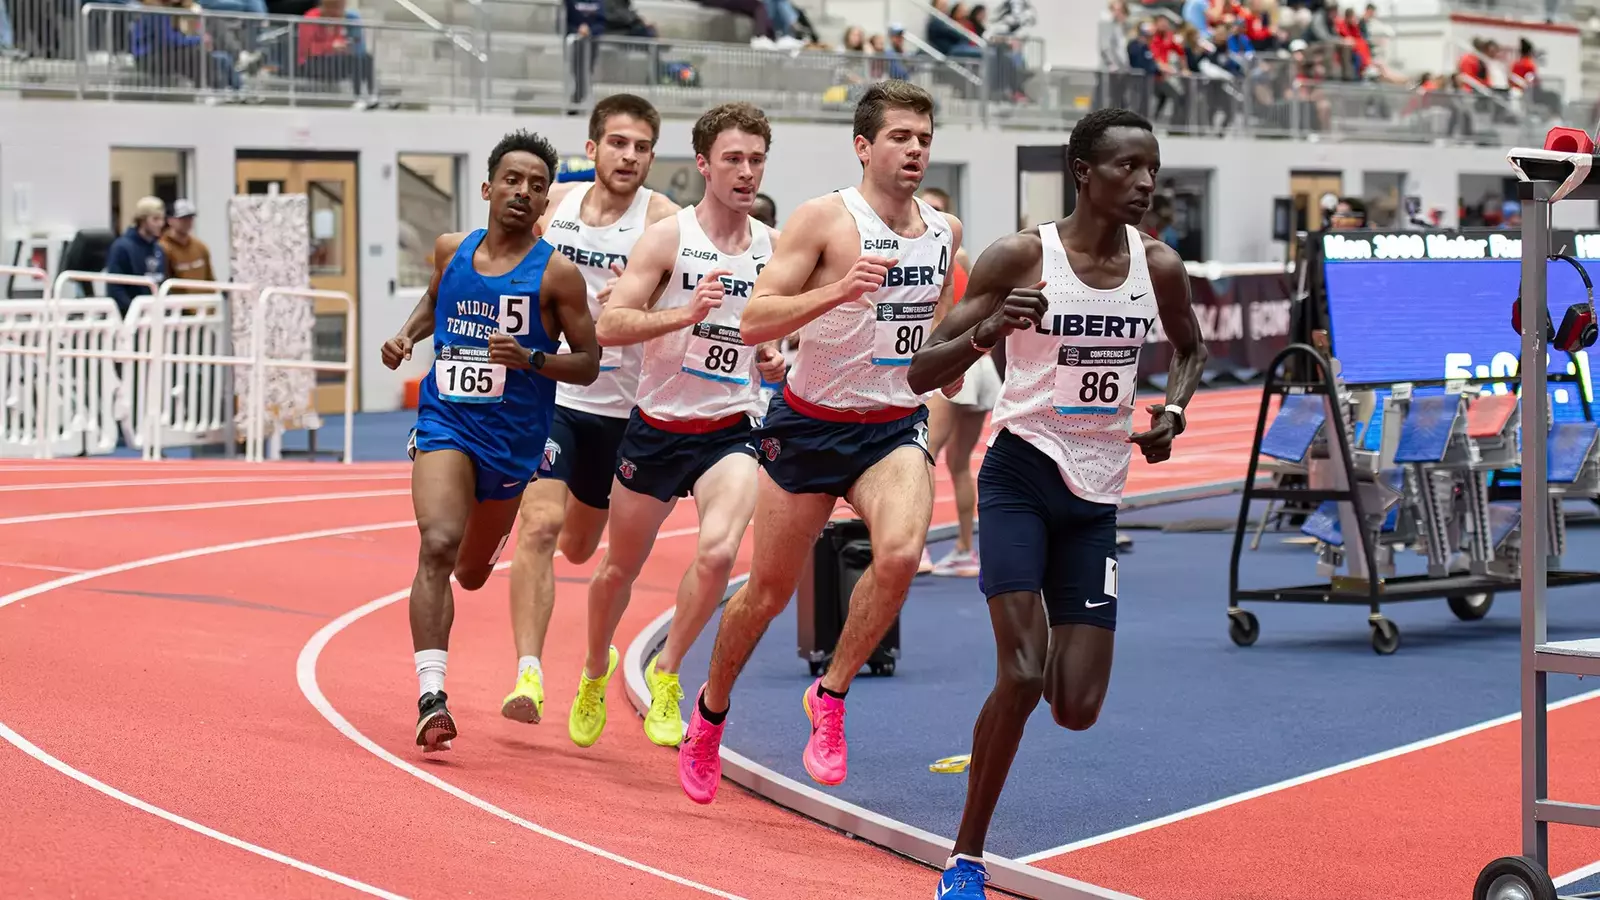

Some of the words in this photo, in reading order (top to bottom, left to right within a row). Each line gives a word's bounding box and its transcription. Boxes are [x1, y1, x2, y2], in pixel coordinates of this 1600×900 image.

[1373, 234, 1425, 259] 3000
[506, 298, 524, 334] 5
[459, 348, 488, 357] CONFERENCE
[895, 325, 923, 355] 80
[704, 345, 738, 374] 89
[446, 365, 493, 393] 165
[1079, 372, 1120, 402] 86
